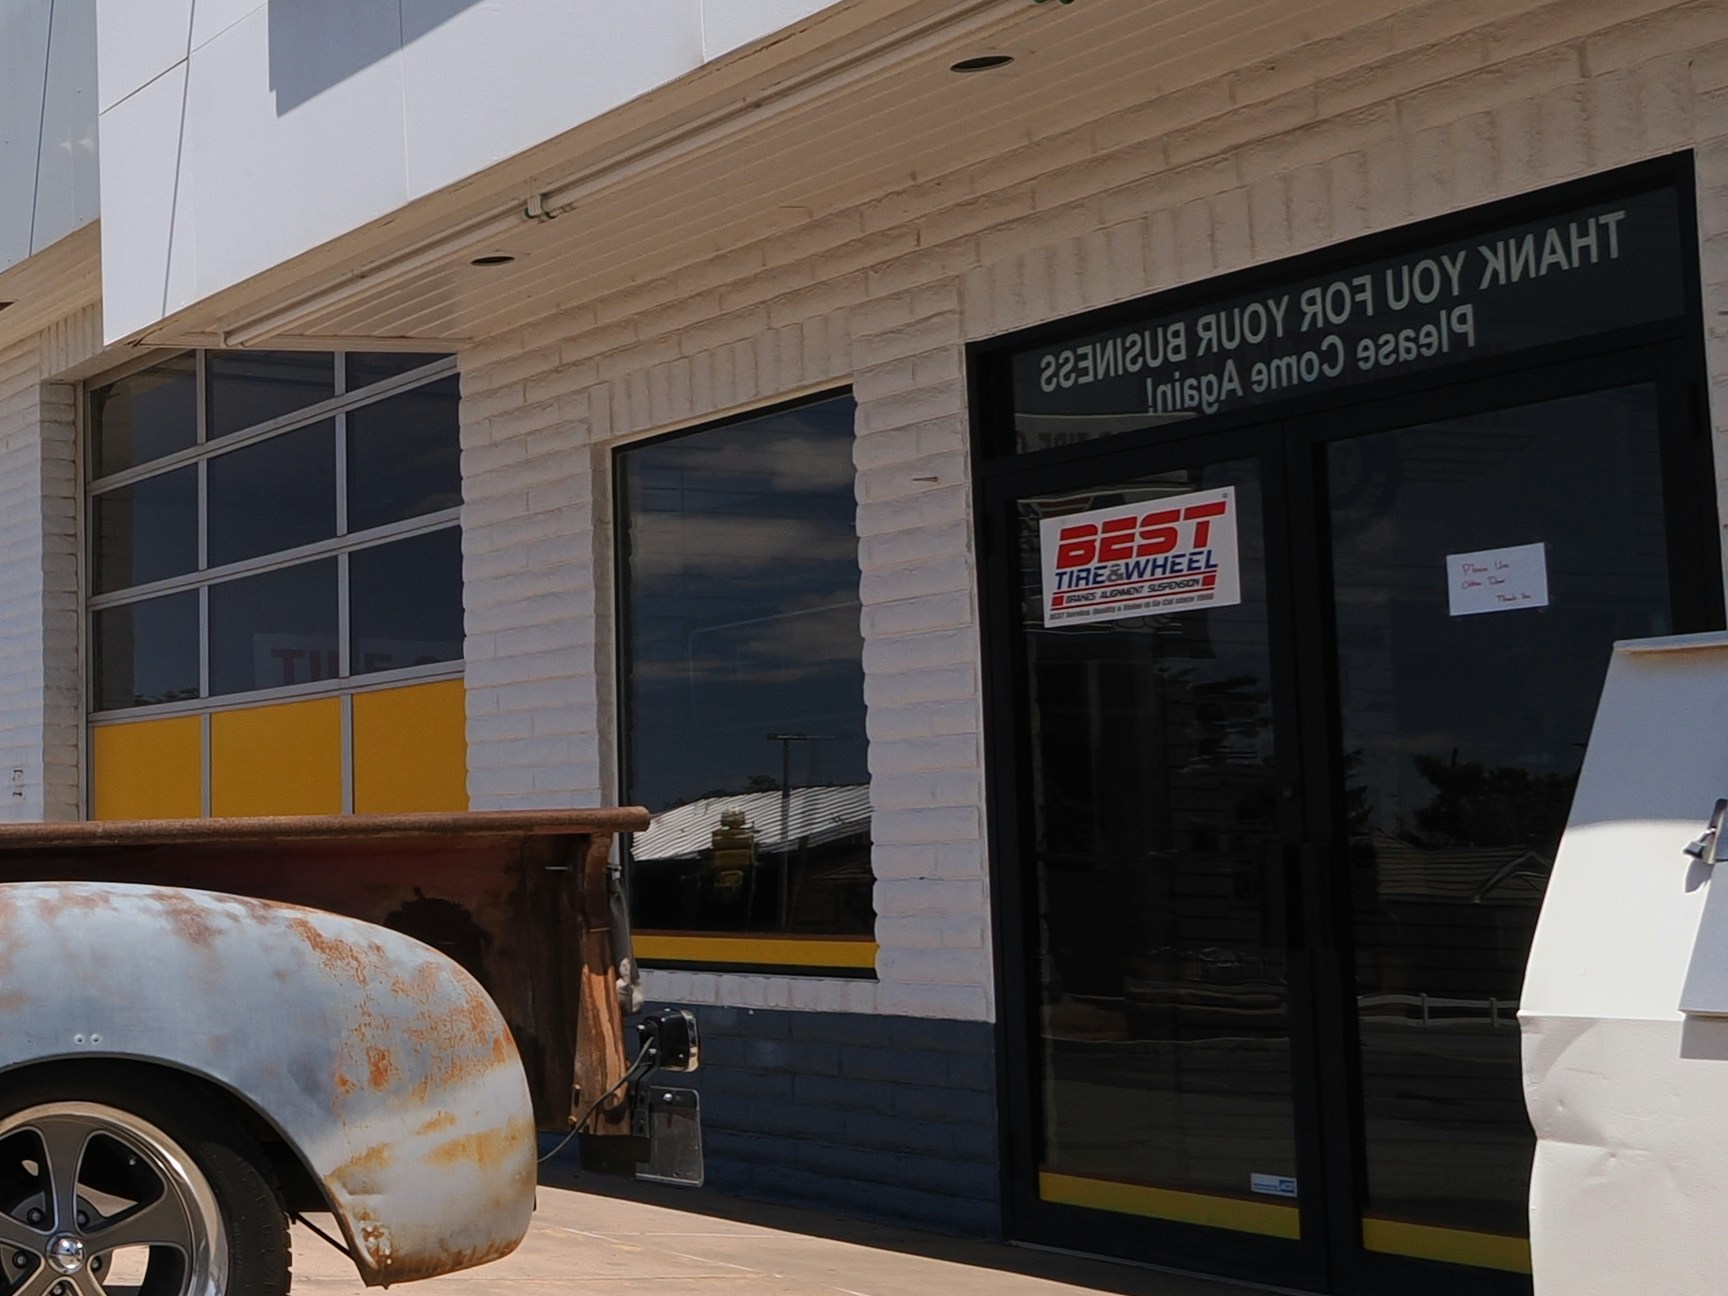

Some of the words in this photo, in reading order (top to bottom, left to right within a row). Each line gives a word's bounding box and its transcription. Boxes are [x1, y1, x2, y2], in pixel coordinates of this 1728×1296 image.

[1056, 500, 1228, 570] BEST
[1065, 592, 1097, 604] BRAKES
[1099, 585, 1144, 600] ALIGNMENT
[1147, 578, 1201, 593] SUSPENSION
